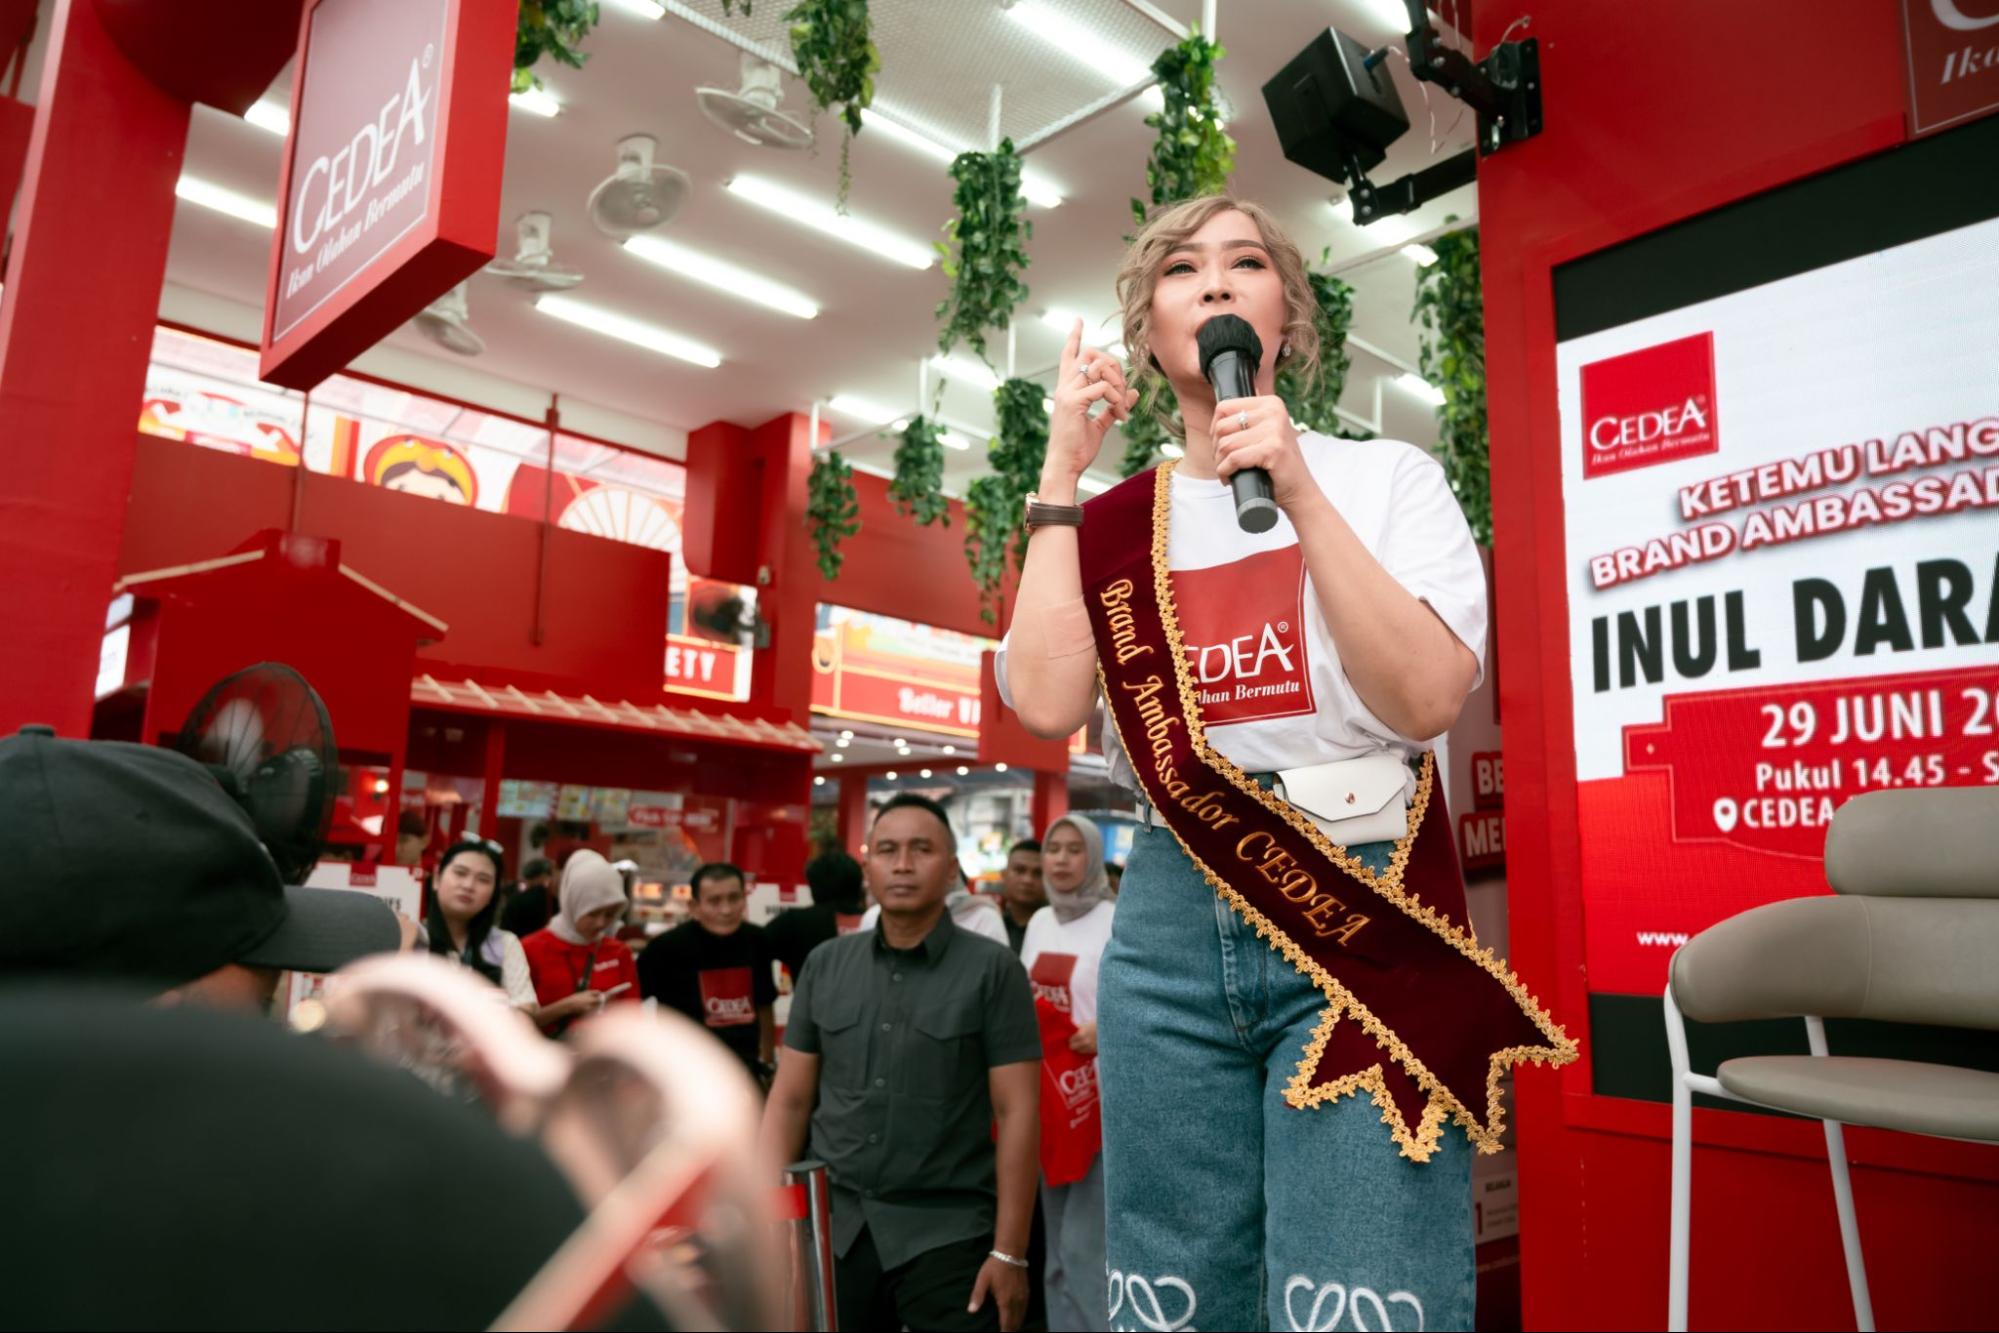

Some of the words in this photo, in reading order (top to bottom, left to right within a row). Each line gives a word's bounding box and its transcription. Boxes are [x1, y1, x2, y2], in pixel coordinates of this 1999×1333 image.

[294, 58, 432, 253] CEDEA
[1590, 398, 1708, 450] CEDEA
[1679, 444, 1860, 520] KETEMU
[1866, 417, 1999, 477] LANG
[1590, 521, 1736, 589] BRAND
[1100, 578, 1154, 666] Brand
[1185, 623, 1295, 684] DEA
[1592, 589, 1761, 693] INUL
[1792, 550, 1999, 664] DAR
[1235, 680, 1300, 700] Bermutu
[1761, 701, 1816, 748] 29
[1830, 690, 1943, 745] JUNI
[1962, 687, 1999, 735] 2
[1122, 674, 1240, 831] Ambassador
[1755, 758, 1842, 792] Pukul
[1852, 754, 1946, 787] 14.45
[1464, 817, 1506, 857] ME
[1743, 797, 1834, 829] CEDEA
[1235, 830, 1370, 948] CEDEA
